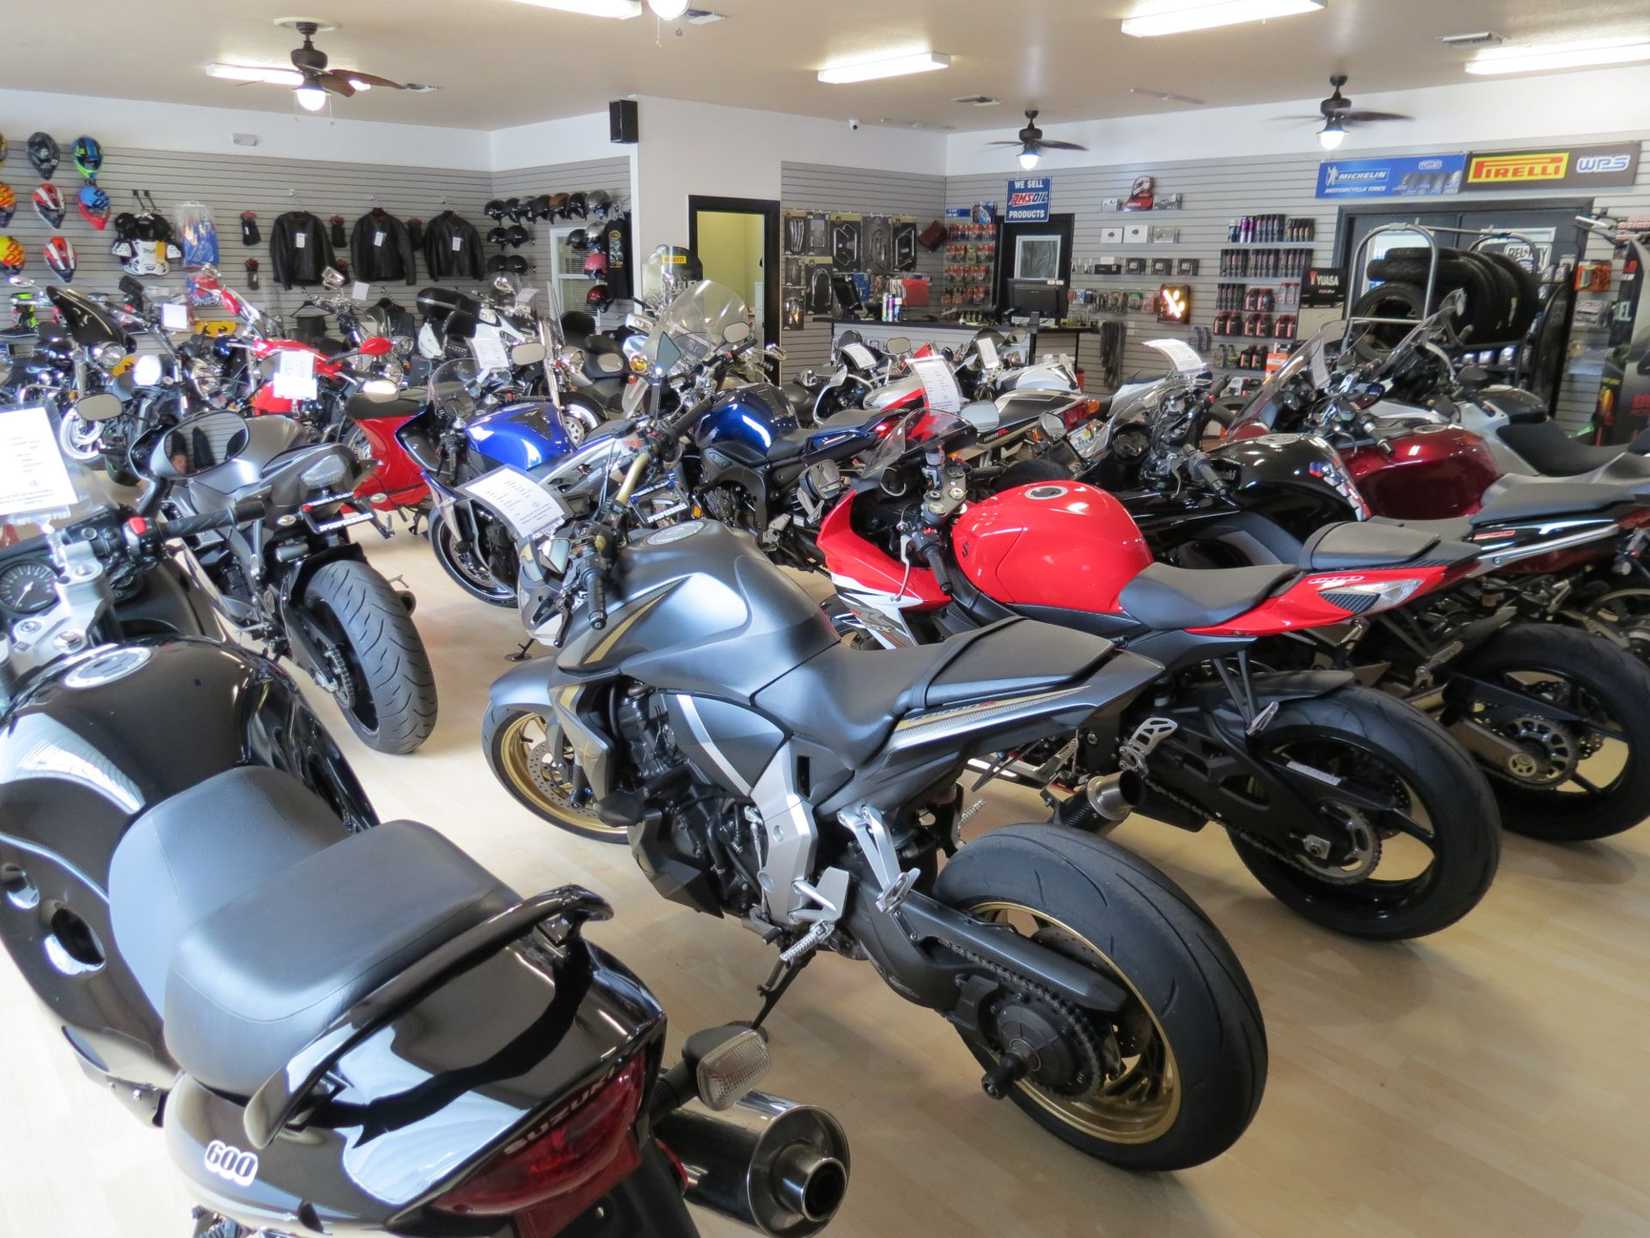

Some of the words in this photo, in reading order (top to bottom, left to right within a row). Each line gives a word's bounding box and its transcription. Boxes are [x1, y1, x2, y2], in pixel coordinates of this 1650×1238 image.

[1472, 156, 1564, 179] PIRELLI
[1338, 171, 1387, 180] MICHELIN
[1014, 180, 1024, 189] WE
[1027, 180, 1043, 188] SELL
[1008, 210, 1045, 219] PRODUCTS
[205, 1140, 257, 1185] 600
